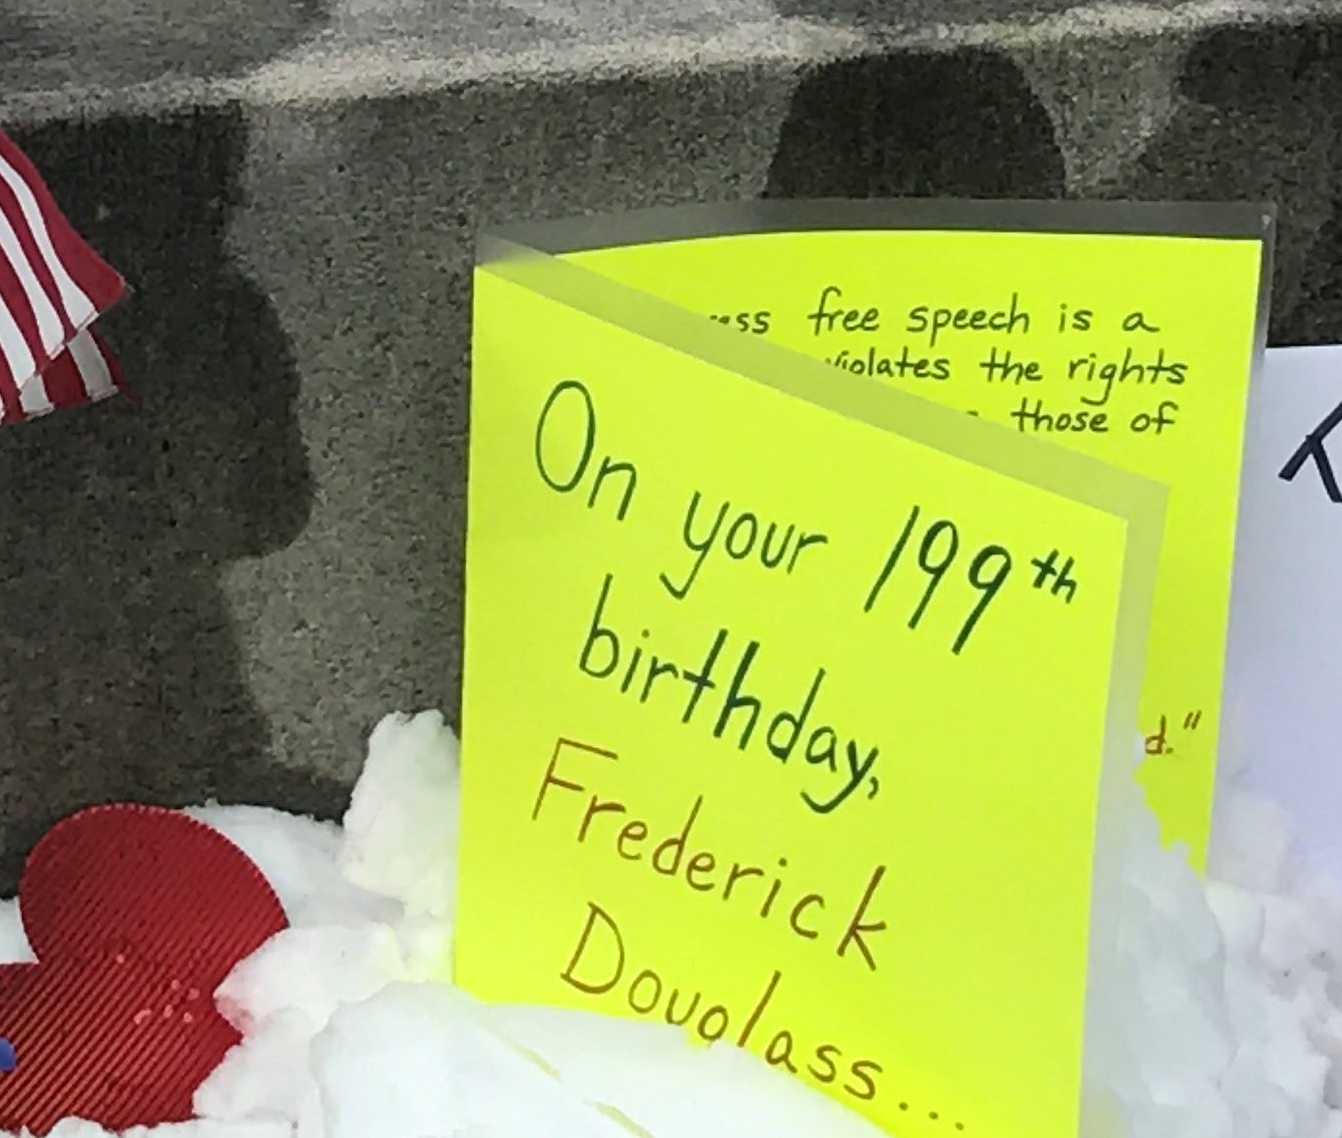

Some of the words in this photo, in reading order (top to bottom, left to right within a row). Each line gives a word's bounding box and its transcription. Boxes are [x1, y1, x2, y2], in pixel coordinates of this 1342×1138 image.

[807, 285, 882, 337] free
[905, 292, 1030, 348] speech
[1058, 302, 1094, 334] is
[1121, 309, 1161, 334] a
[979, 347, 1044, 386] the
[1067, 347, 1189, 407] rights
[1010, 396, 1110, 434] those
[1129, 400, 1181, 436] of
[534, 379, 638, 522] On
[659, 489, 829, 600] your
[577, 573, 881, 815] birthday,
[531, 736, 889, 972] Frederick
